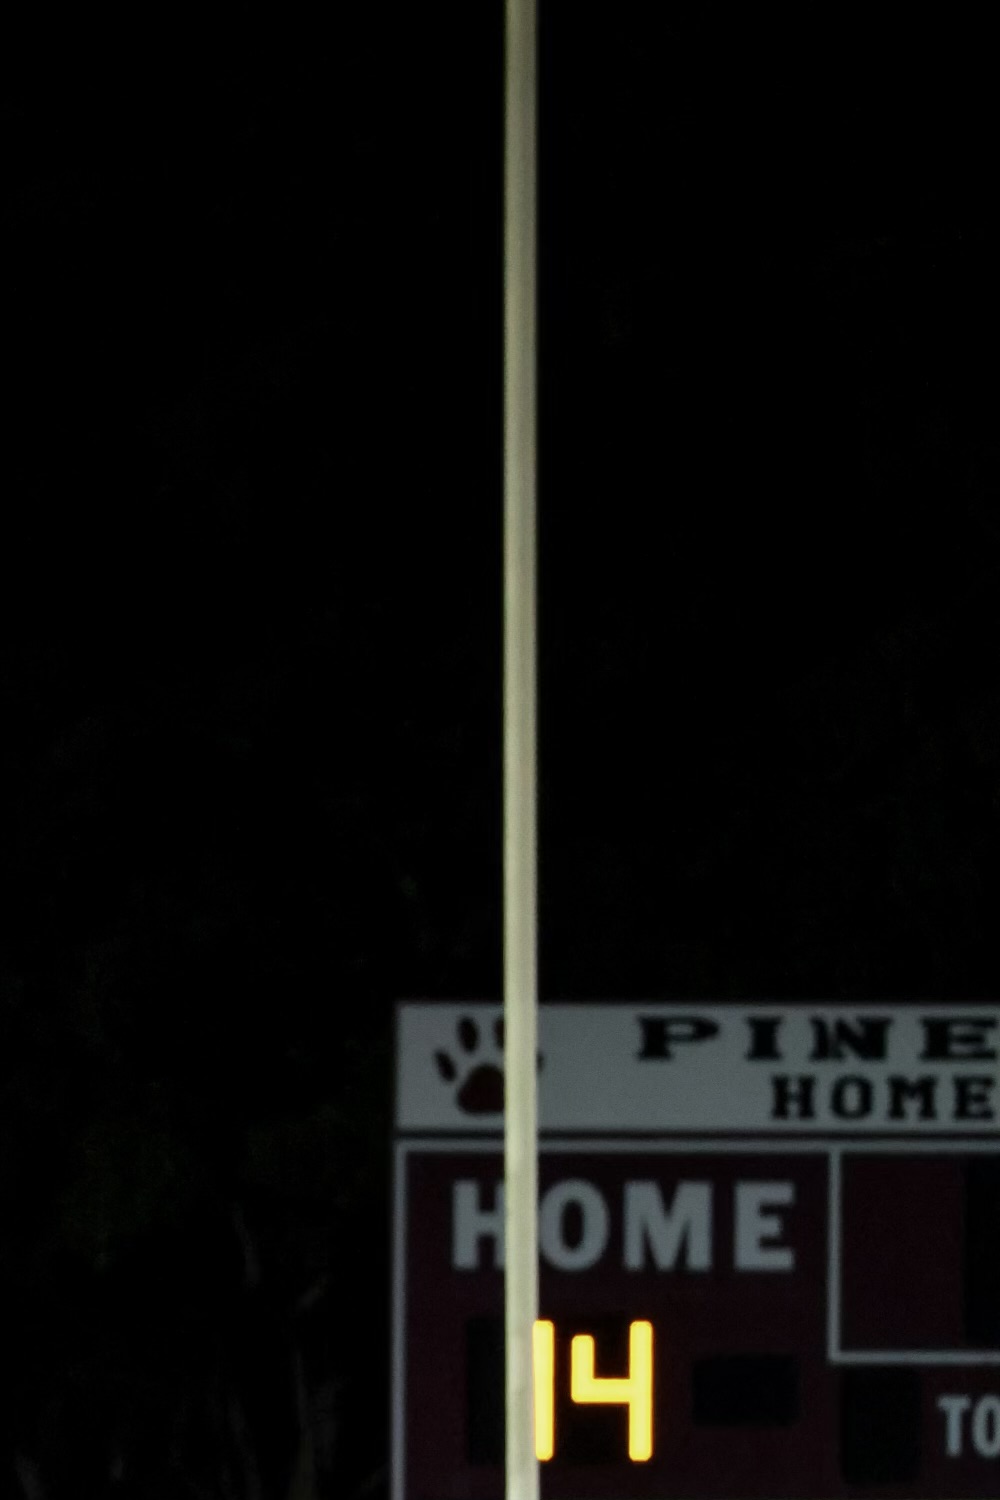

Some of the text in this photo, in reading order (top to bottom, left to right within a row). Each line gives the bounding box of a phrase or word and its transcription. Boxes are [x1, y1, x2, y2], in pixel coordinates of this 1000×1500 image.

[638, 1015, 997, 1061] PINE
[771, 1074, 994, 1119] HOME
[451, 1178, 795, 1272] HOME
[533, 1319, 654, 1462] 14
[937, 1393, 1000, 1458] TO
